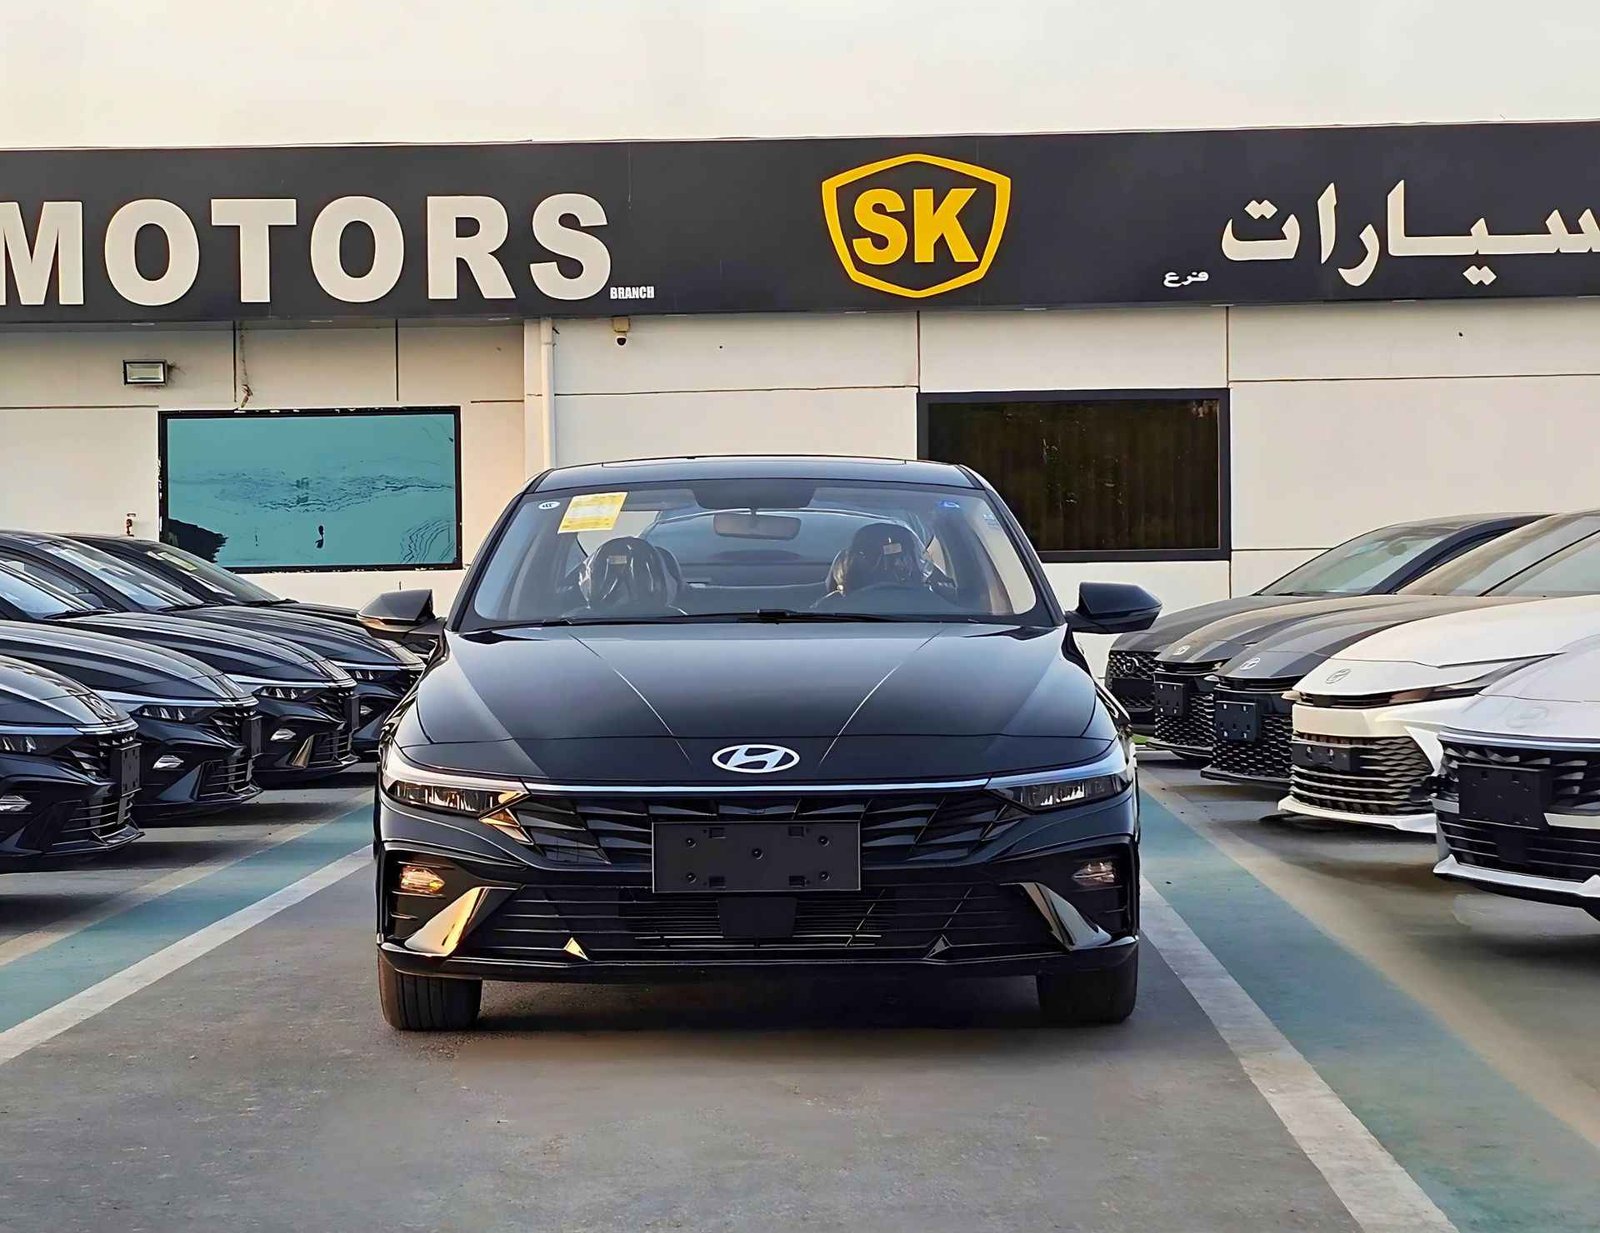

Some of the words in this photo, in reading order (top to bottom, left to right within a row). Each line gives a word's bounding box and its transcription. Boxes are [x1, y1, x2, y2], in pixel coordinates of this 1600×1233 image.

[0, 193, 611, 306] MOTORS
[852, 187, 979, 266] SK
[609, 286, 655, 300] BRANCH
